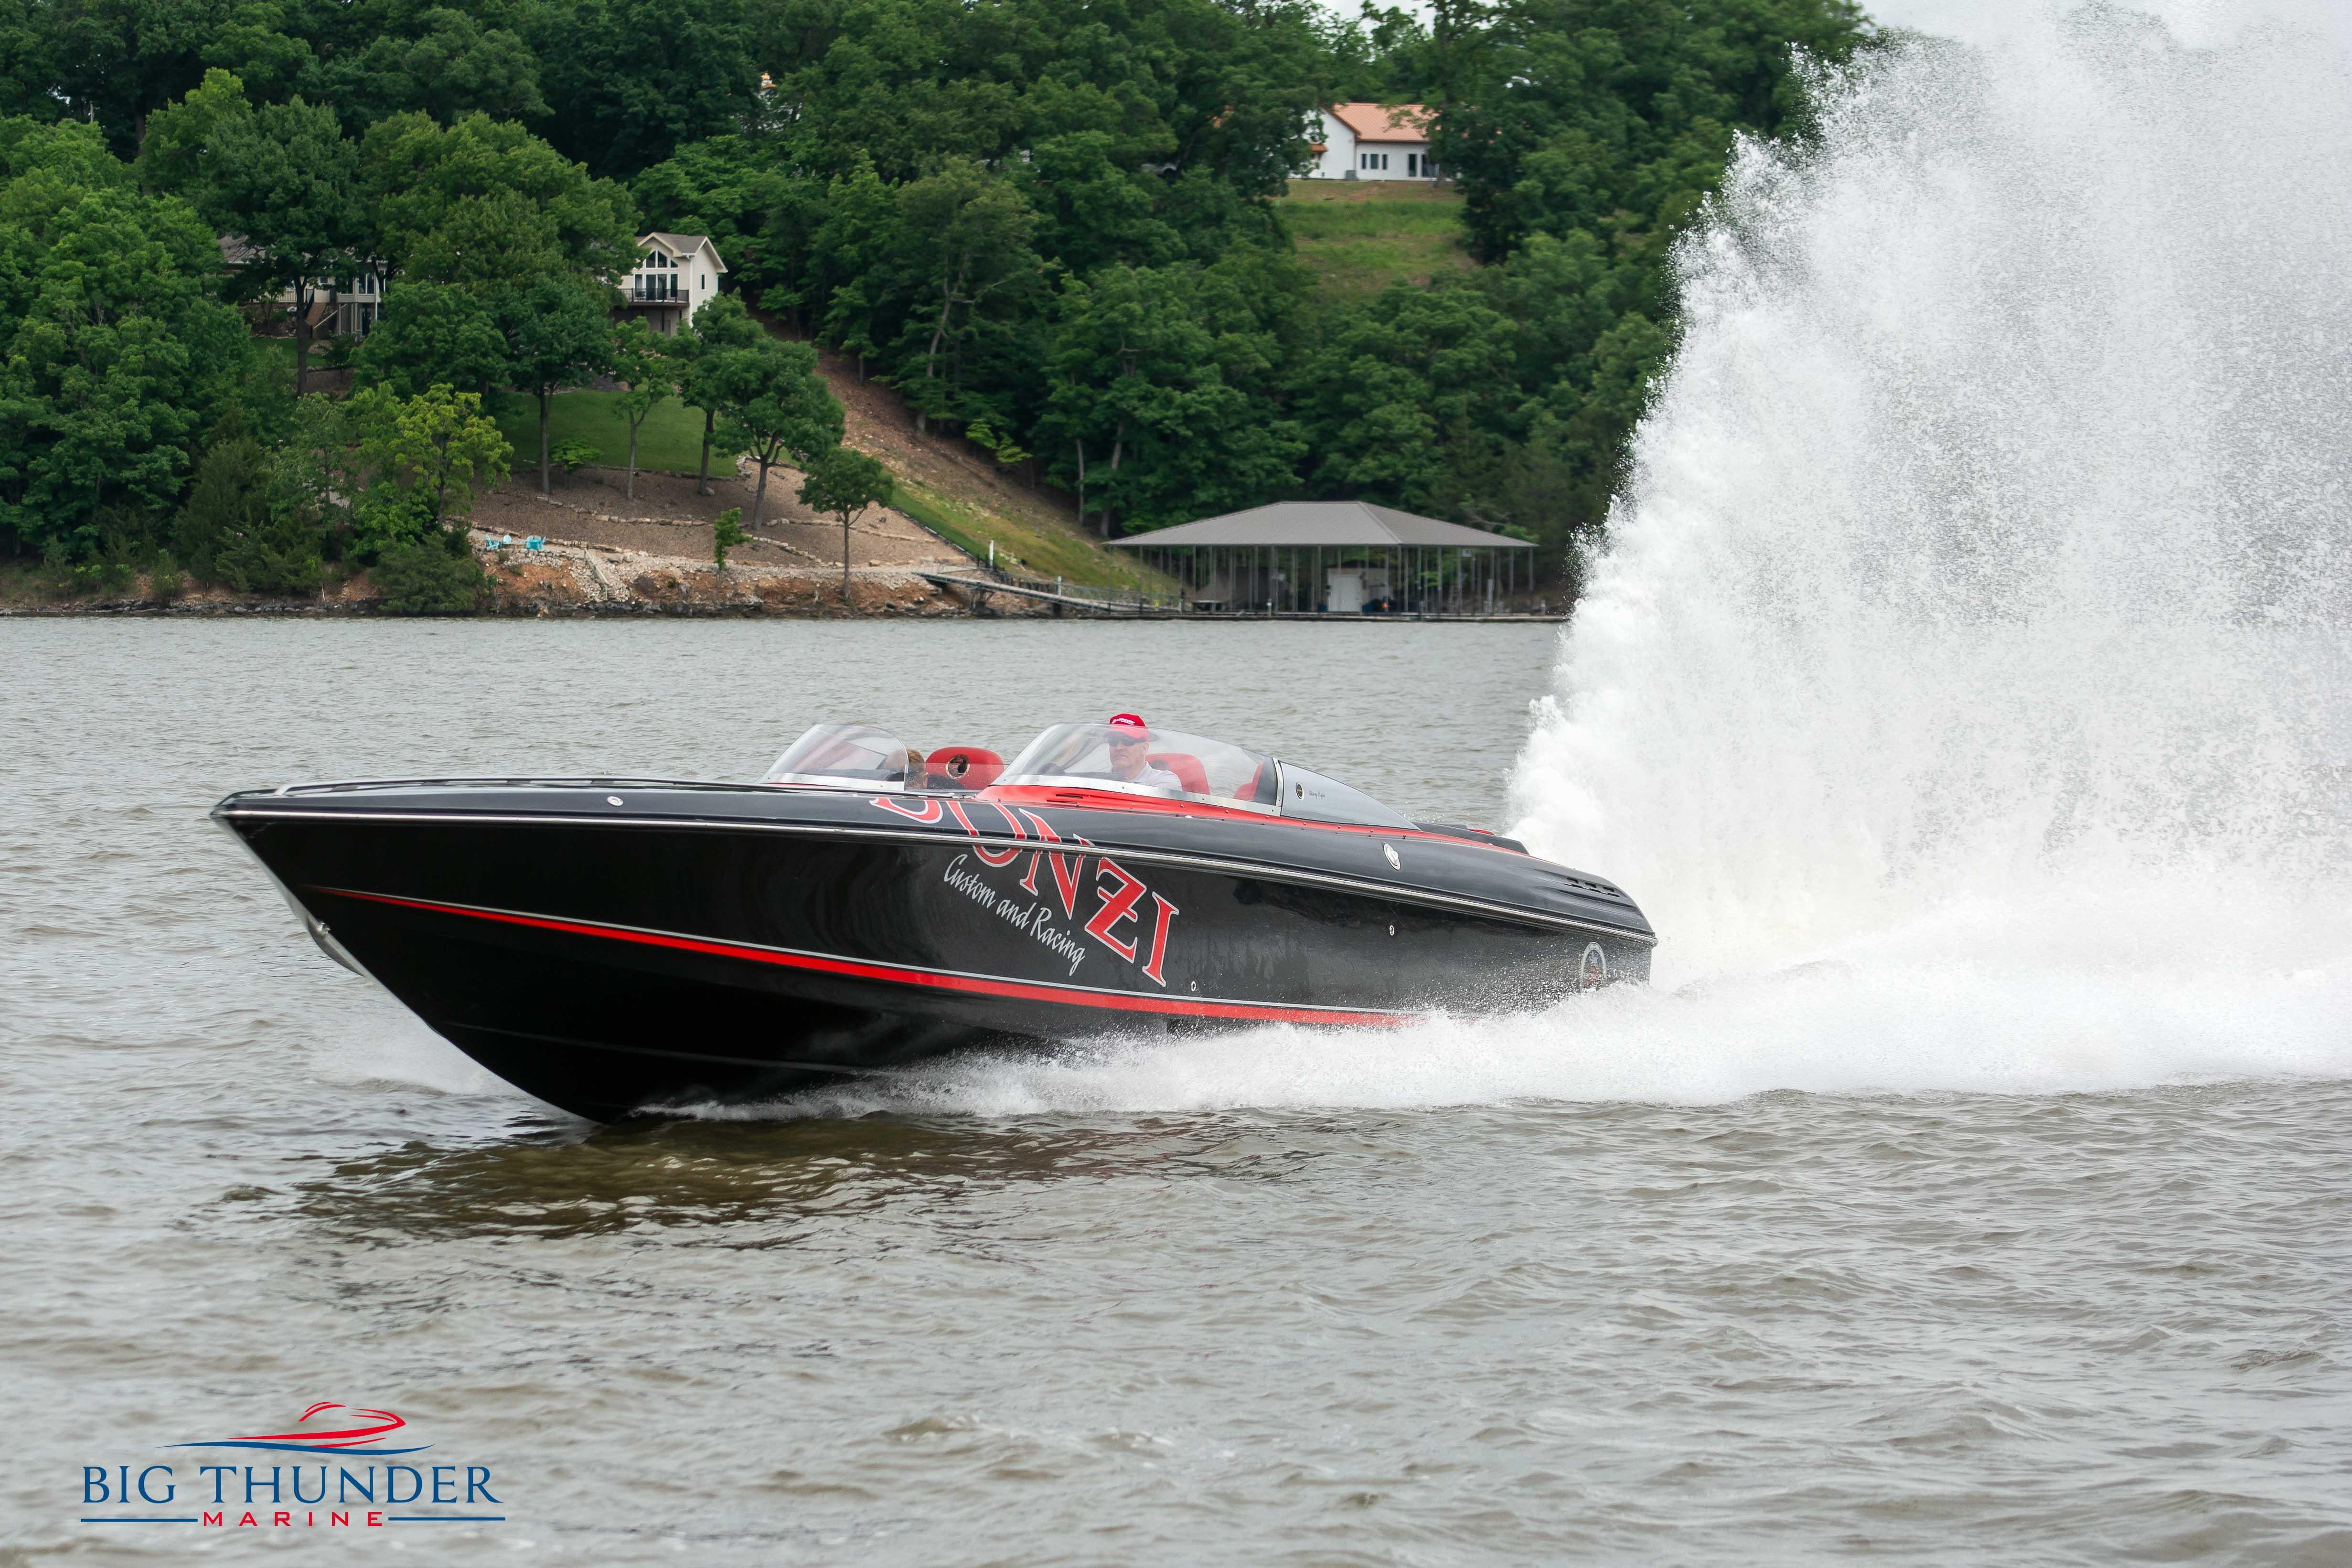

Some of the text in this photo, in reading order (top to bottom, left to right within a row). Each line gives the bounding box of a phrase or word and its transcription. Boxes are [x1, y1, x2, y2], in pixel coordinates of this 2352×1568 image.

[944, 854, 1086, 976] Custom and Racing
